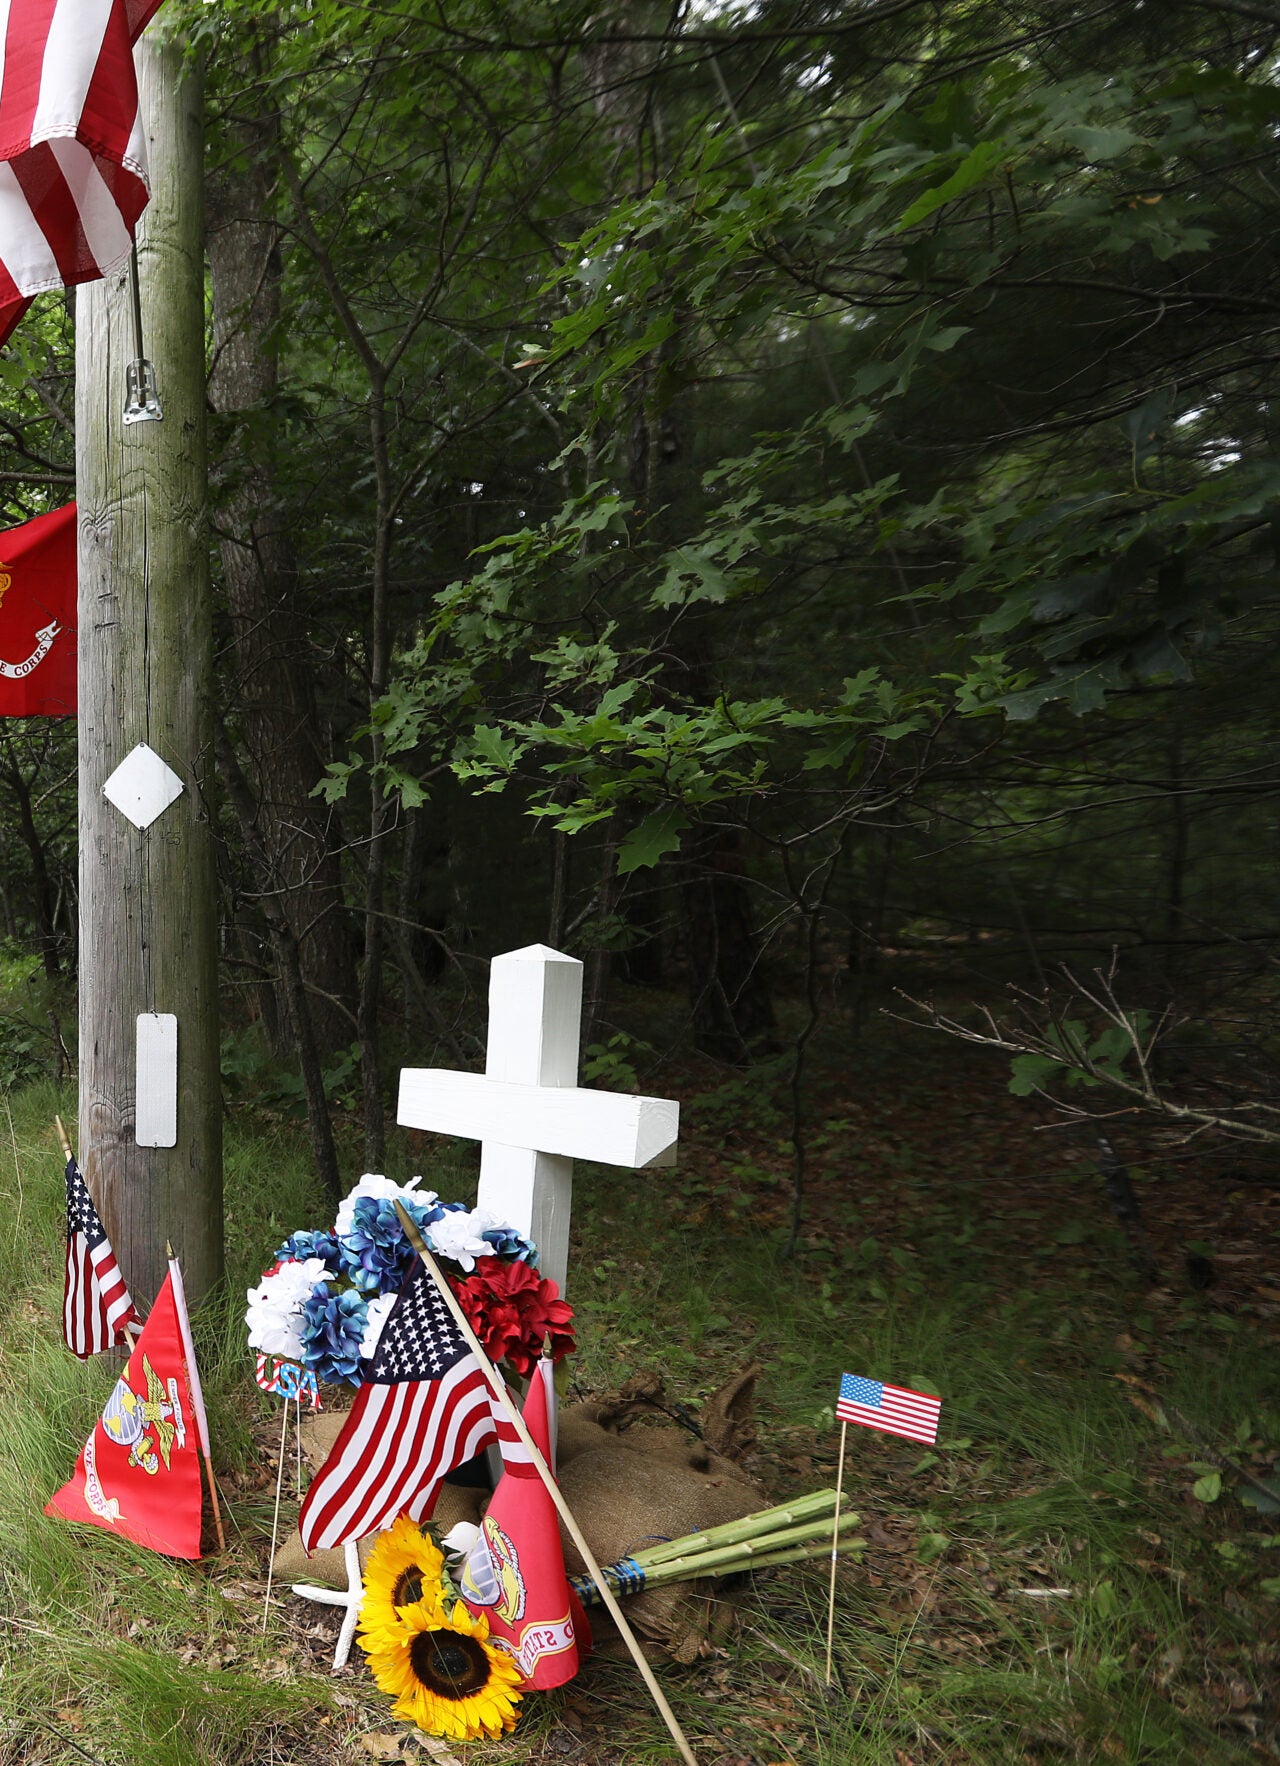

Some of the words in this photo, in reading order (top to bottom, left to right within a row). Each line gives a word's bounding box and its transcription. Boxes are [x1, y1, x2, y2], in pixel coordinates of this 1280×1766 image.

[14, 643, 48, 677] CORPS
[255, 1353, 324, 1409] USA
[89, 1473, 107, 1511] CORPS
